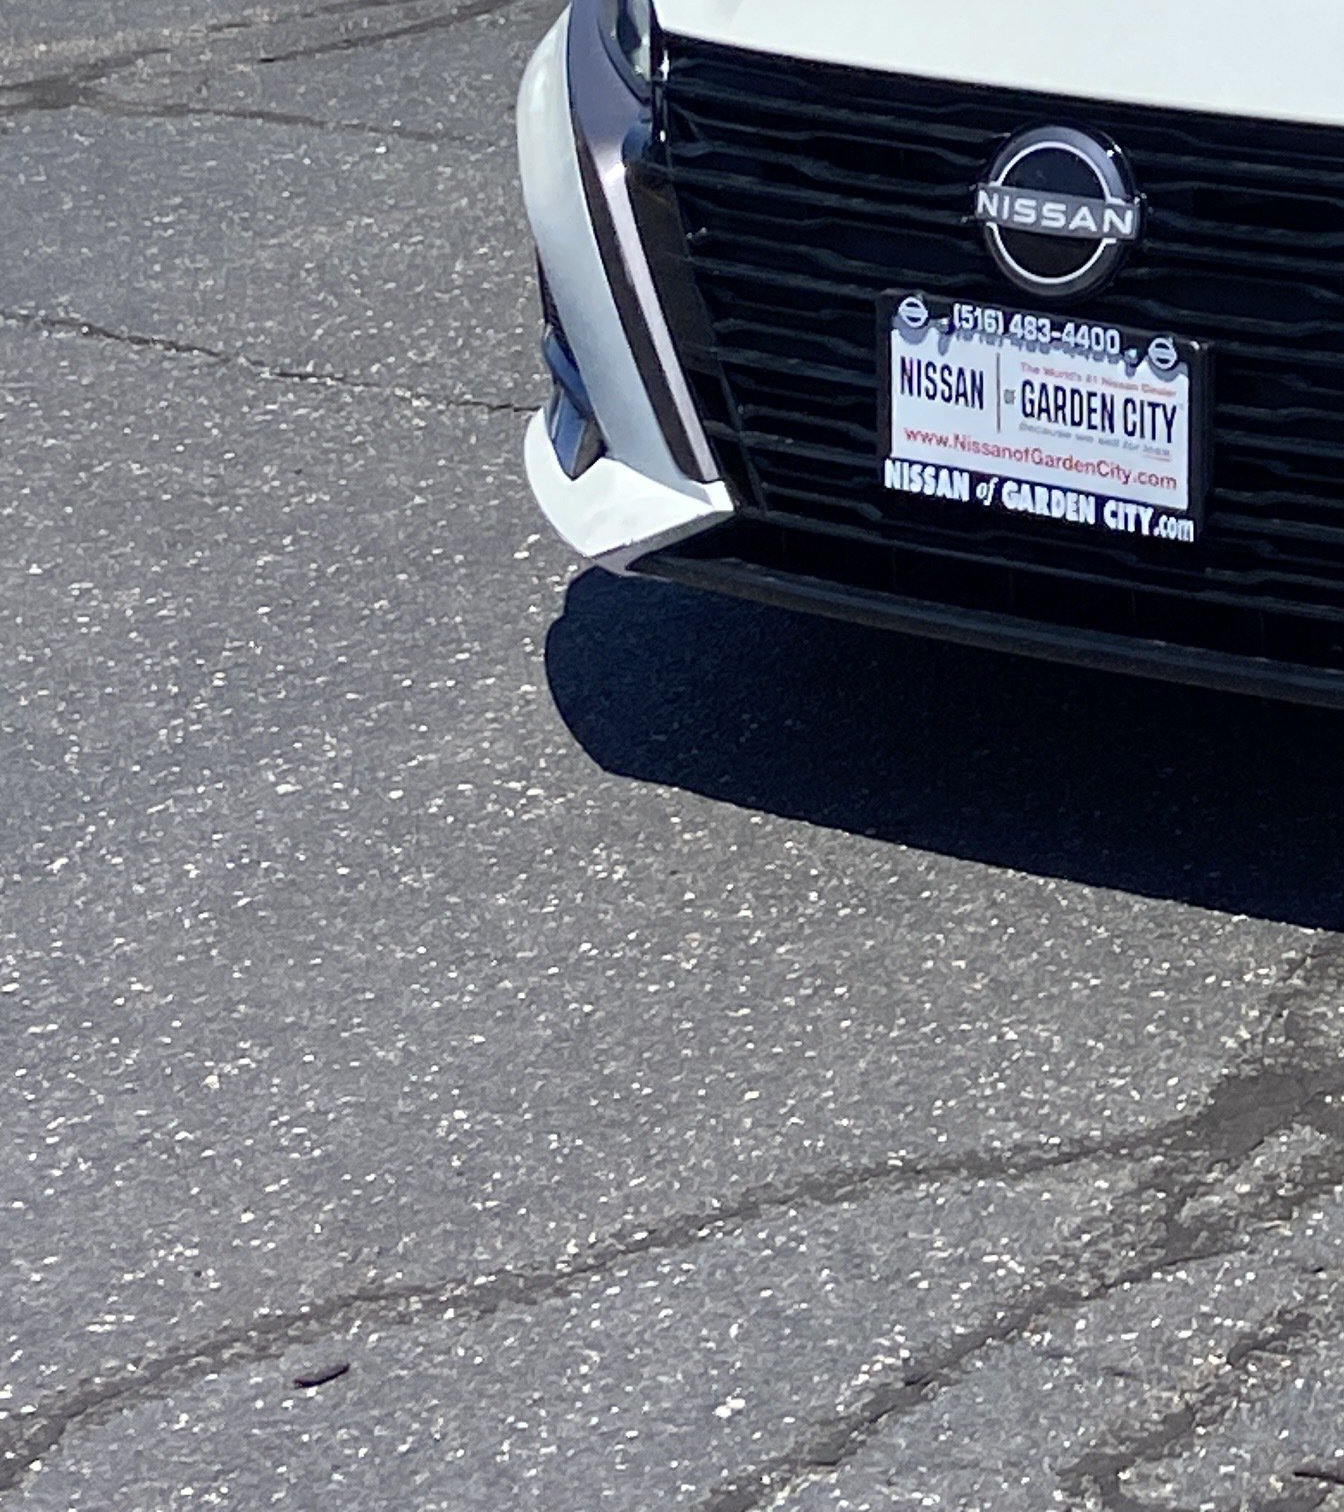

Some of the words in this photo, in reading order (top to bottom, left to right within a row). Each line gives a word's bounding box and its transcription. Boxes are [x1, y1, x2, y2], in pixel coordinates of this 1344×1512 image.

[976, 189, 1134, 235] NISSAN
[953, 303, 1004, 332] (516)
[1009, 313, 1121, 354] 483-4400
[900, 356, 984, 410] NISSAN
[1021, 379, 1115, 434] GARDEN
[1123, 398, 1177, 444] CITY
[904, 426, 1178, 491] www.NissanofGardenCity.com
[884, 458, 970, 502] NISSAN
[976, 477, 999, 506] of
[1001, 482, 1095, 525] GARDEN
